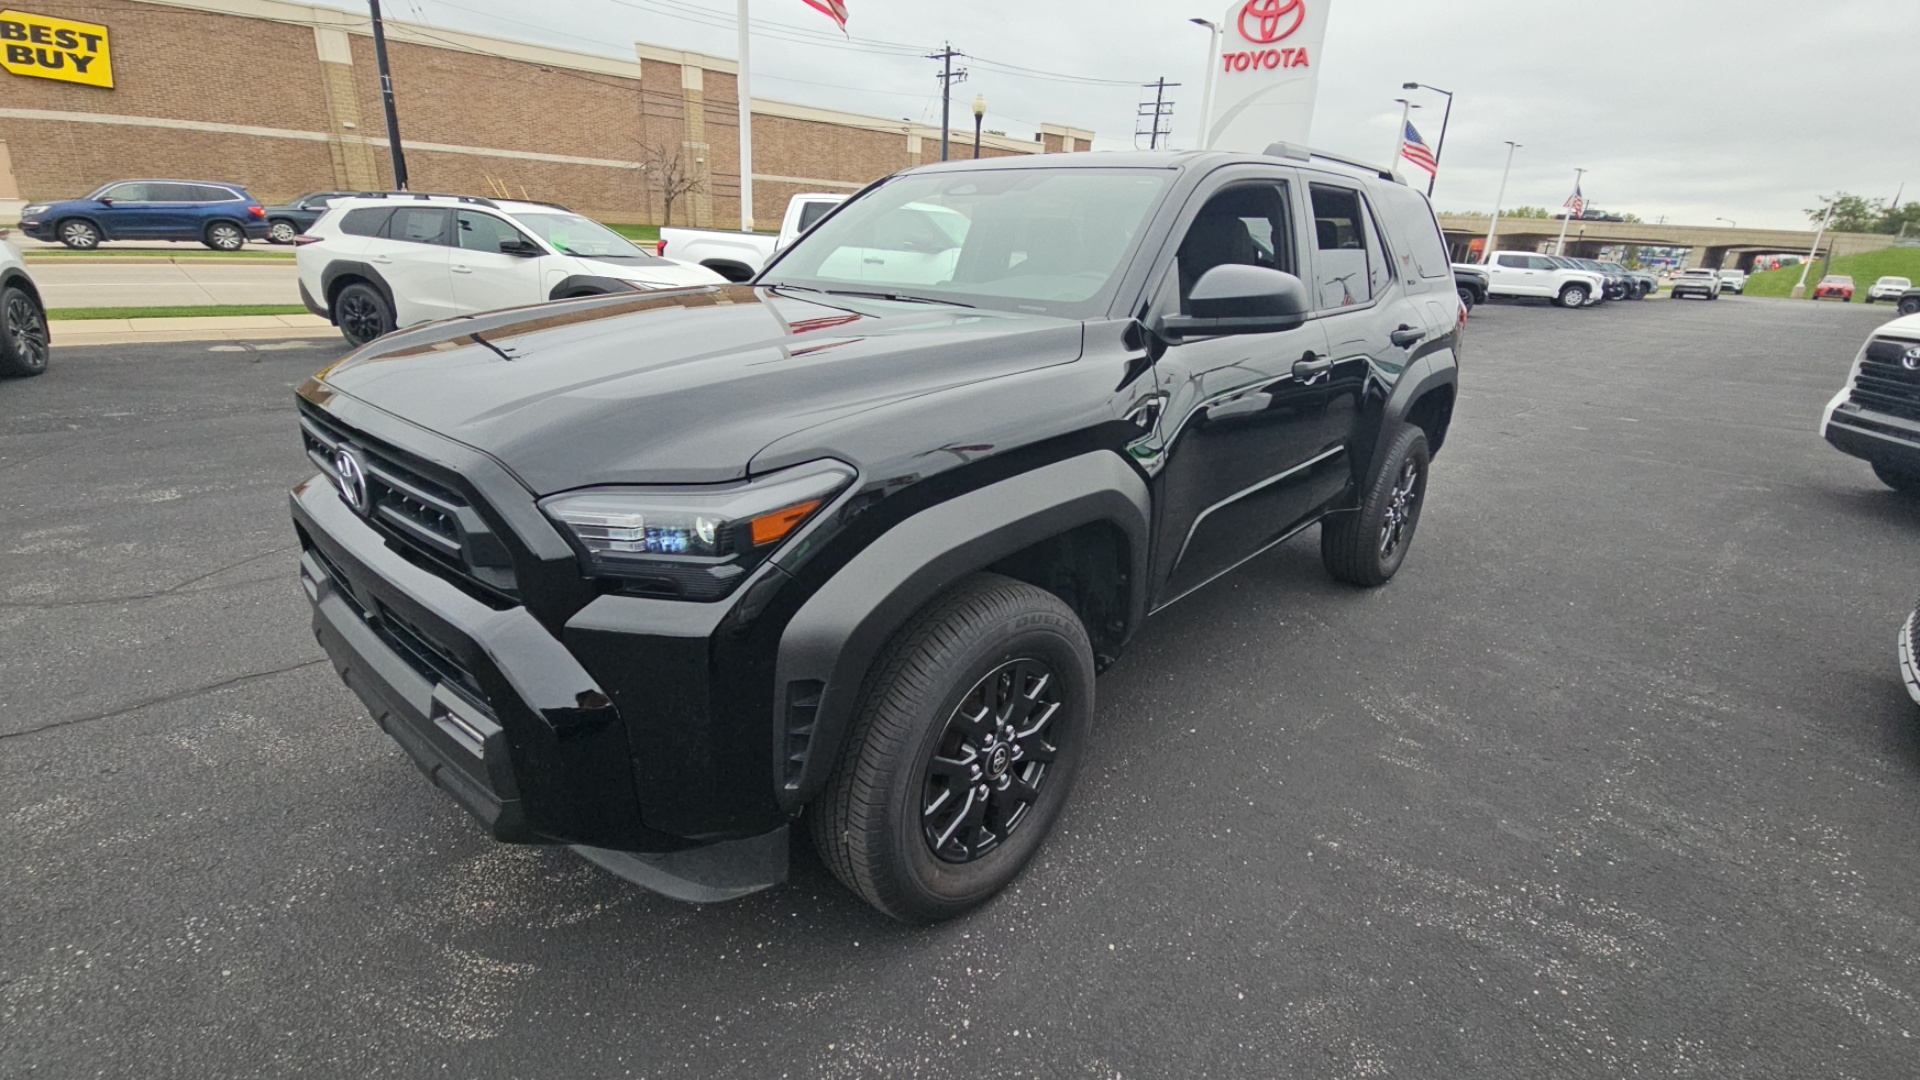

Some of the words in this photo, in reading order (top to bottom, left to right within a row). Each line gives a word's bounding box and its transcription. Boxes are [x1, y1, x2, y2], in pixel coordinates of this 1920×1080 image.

[0, 20, 102, 53] BEST
[6, 44, 95, 73] BUY
[1222, 47, 1309, 73] TOYOTA
